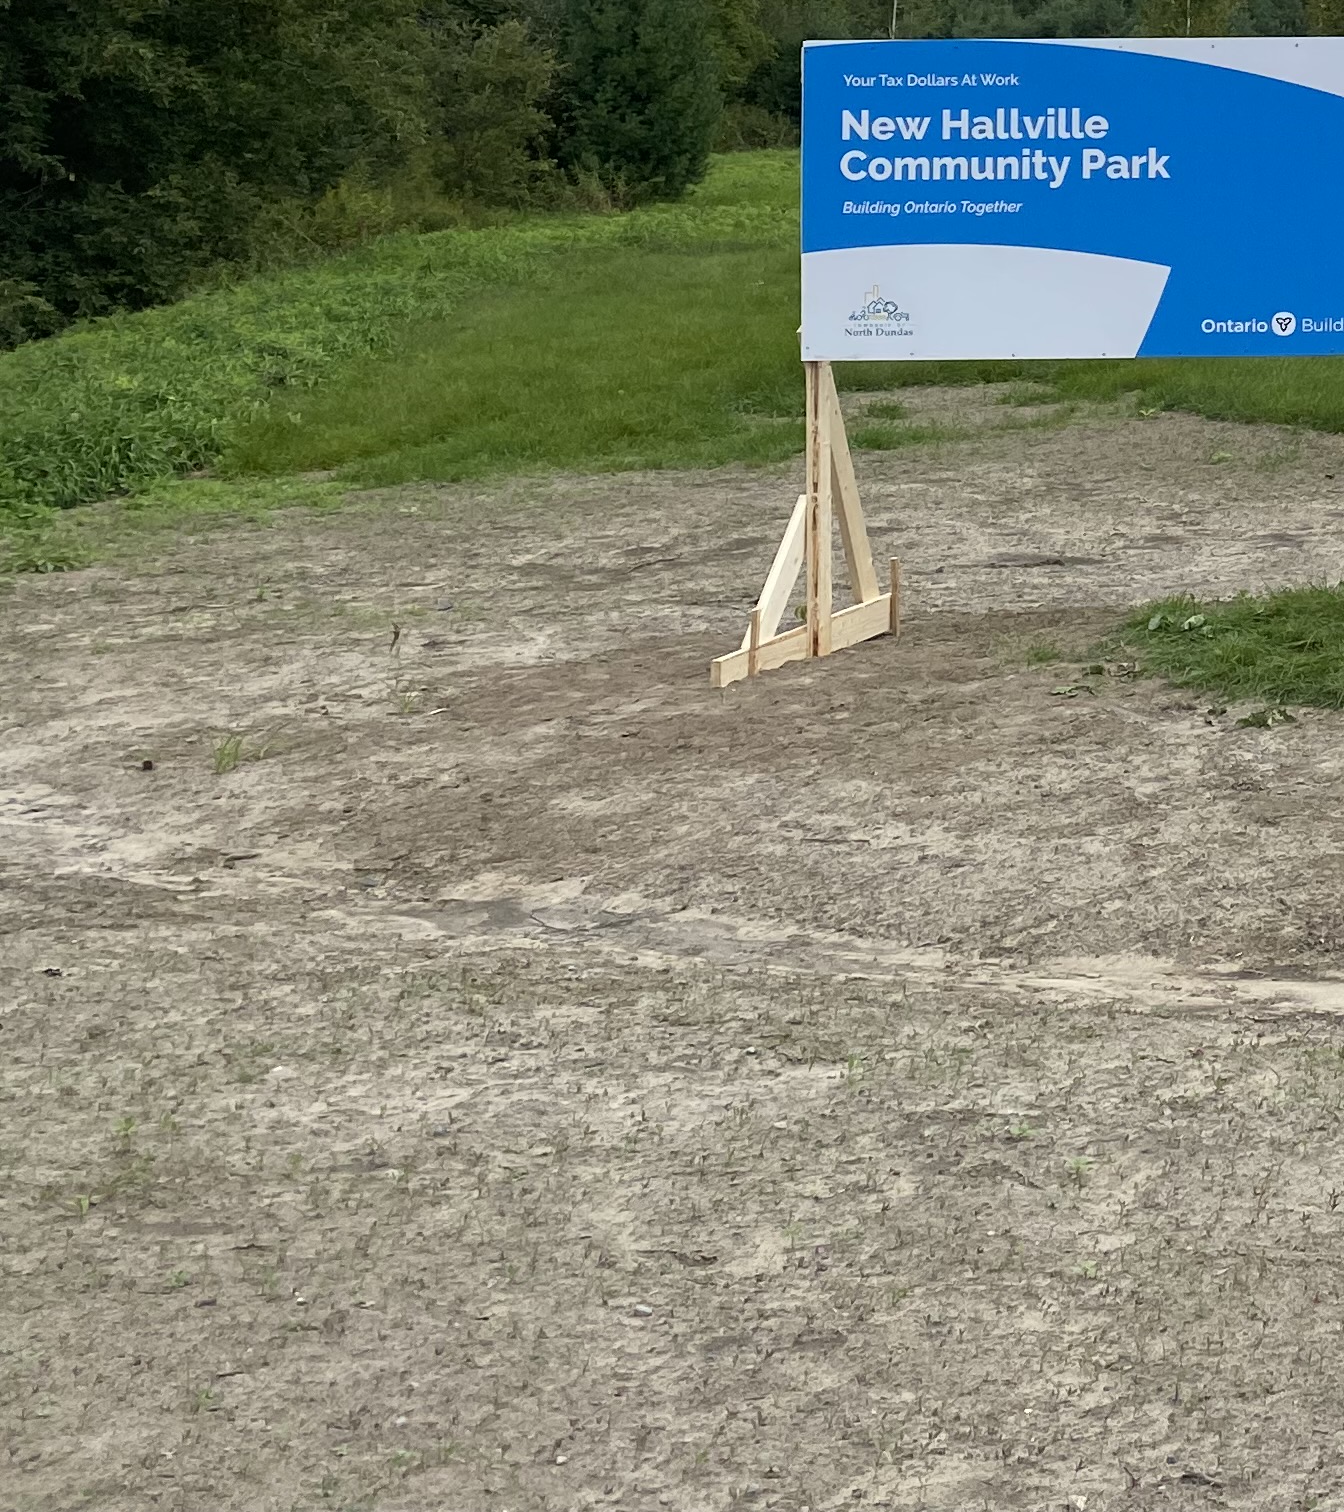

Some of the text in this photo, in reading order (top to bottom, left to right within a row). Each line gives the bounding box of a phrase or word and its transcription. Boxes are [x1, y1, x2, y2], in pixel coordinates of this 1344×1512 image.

[843, 73, 1019, 87] Your Tax Dollars At Work
[841, 107, 1109, 141] New Hallville
[839, 147, 1171, 189] Community Park
[842, 199, 1023, 217] Building Ontario Together
[844, 327, 914, 337] North Dundas
[1200, 319, 1269, 336] Ontario
